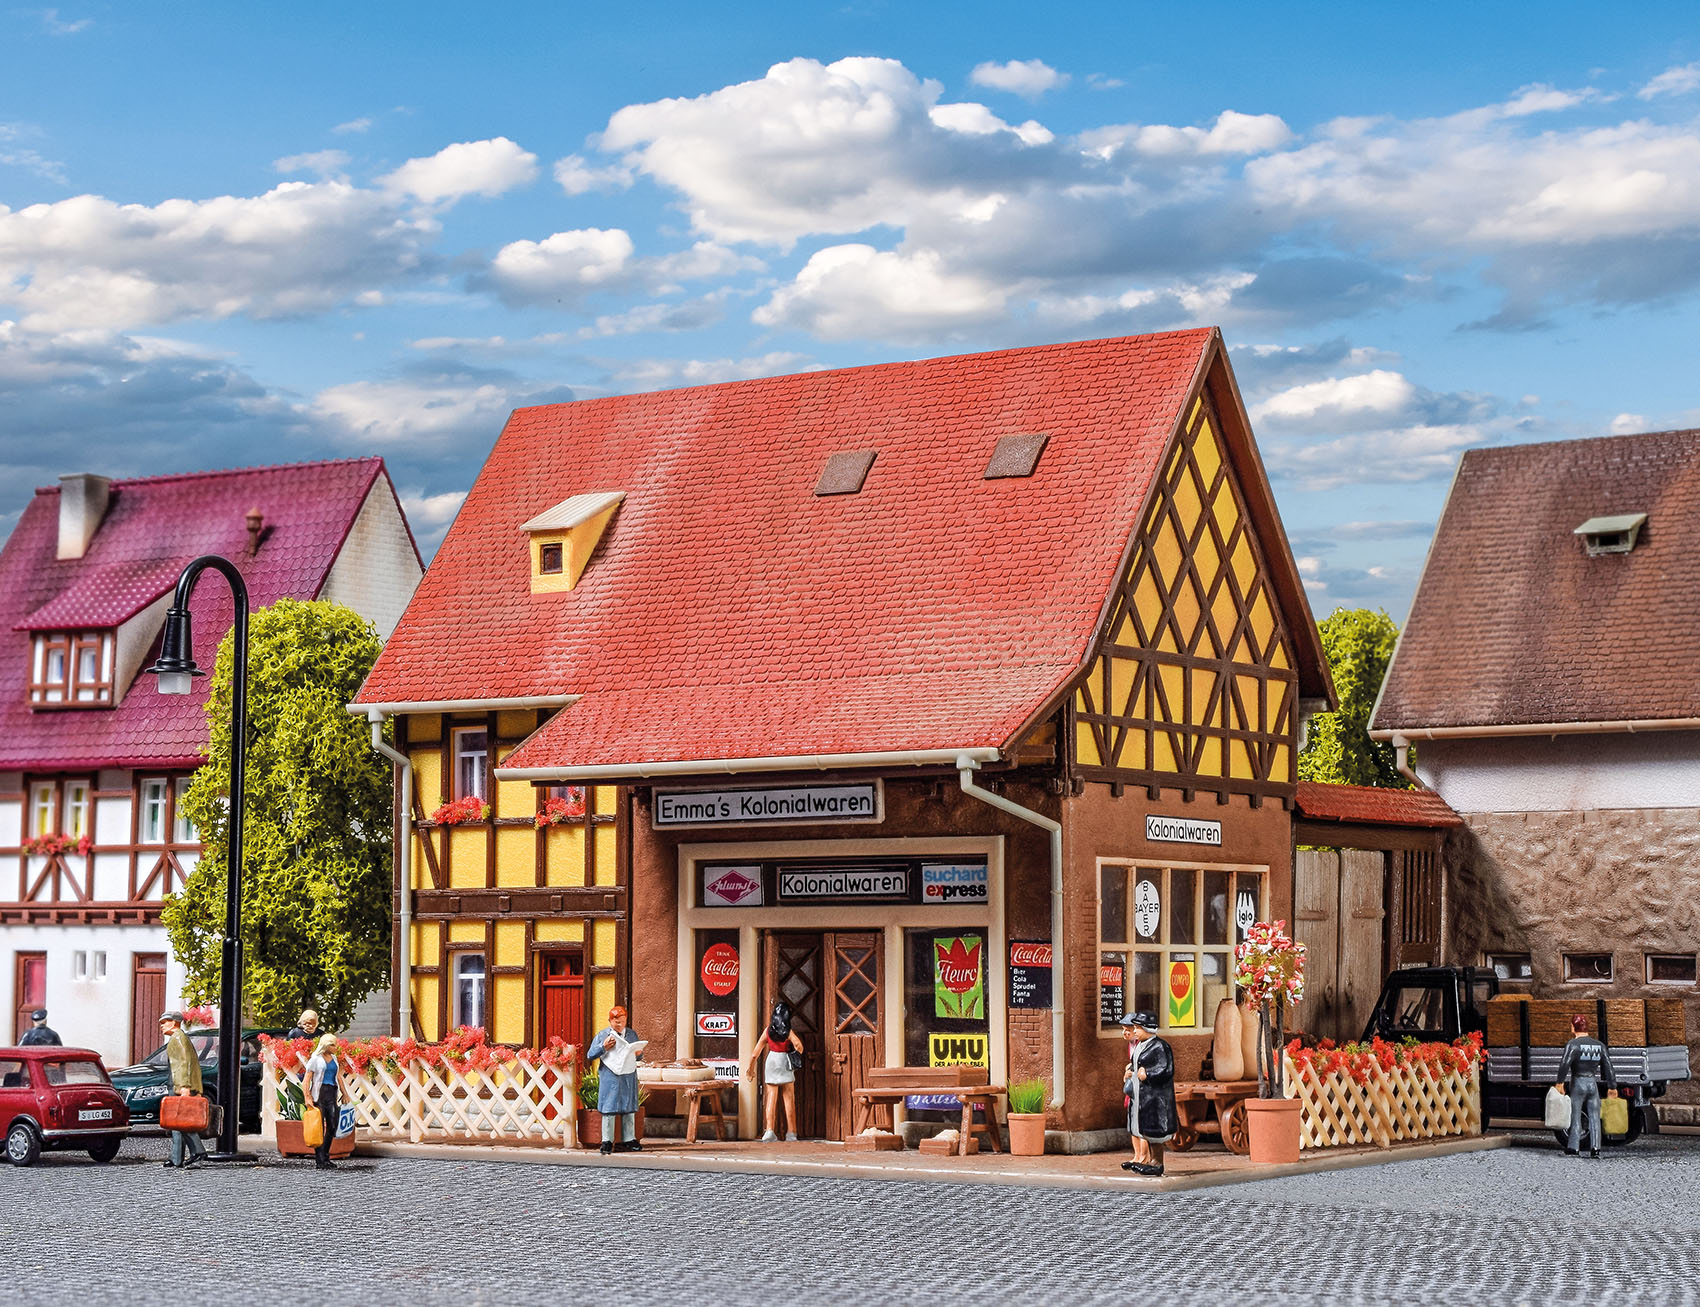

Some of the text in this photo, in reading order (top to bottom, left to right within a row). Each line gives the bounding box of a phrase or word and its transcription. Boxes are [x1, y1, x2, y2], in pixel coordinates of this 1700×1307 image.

[661, 793, 871, 819] Emma's Kolonialwaren
[1148, 818, 1220, 842] Kolonialwaren
[924, 865, 987, 882] suchard
[783, 873, 903, 894] Kolonialwaren
[926, 884, 987, 901] express
[1238, 909, 1253, 925] iglo
[1013, 982, 1036, 990] Sprudel
[705, 1021, 728, 1029] KRAFT
[933, 1038, 984, 1061] UHU
